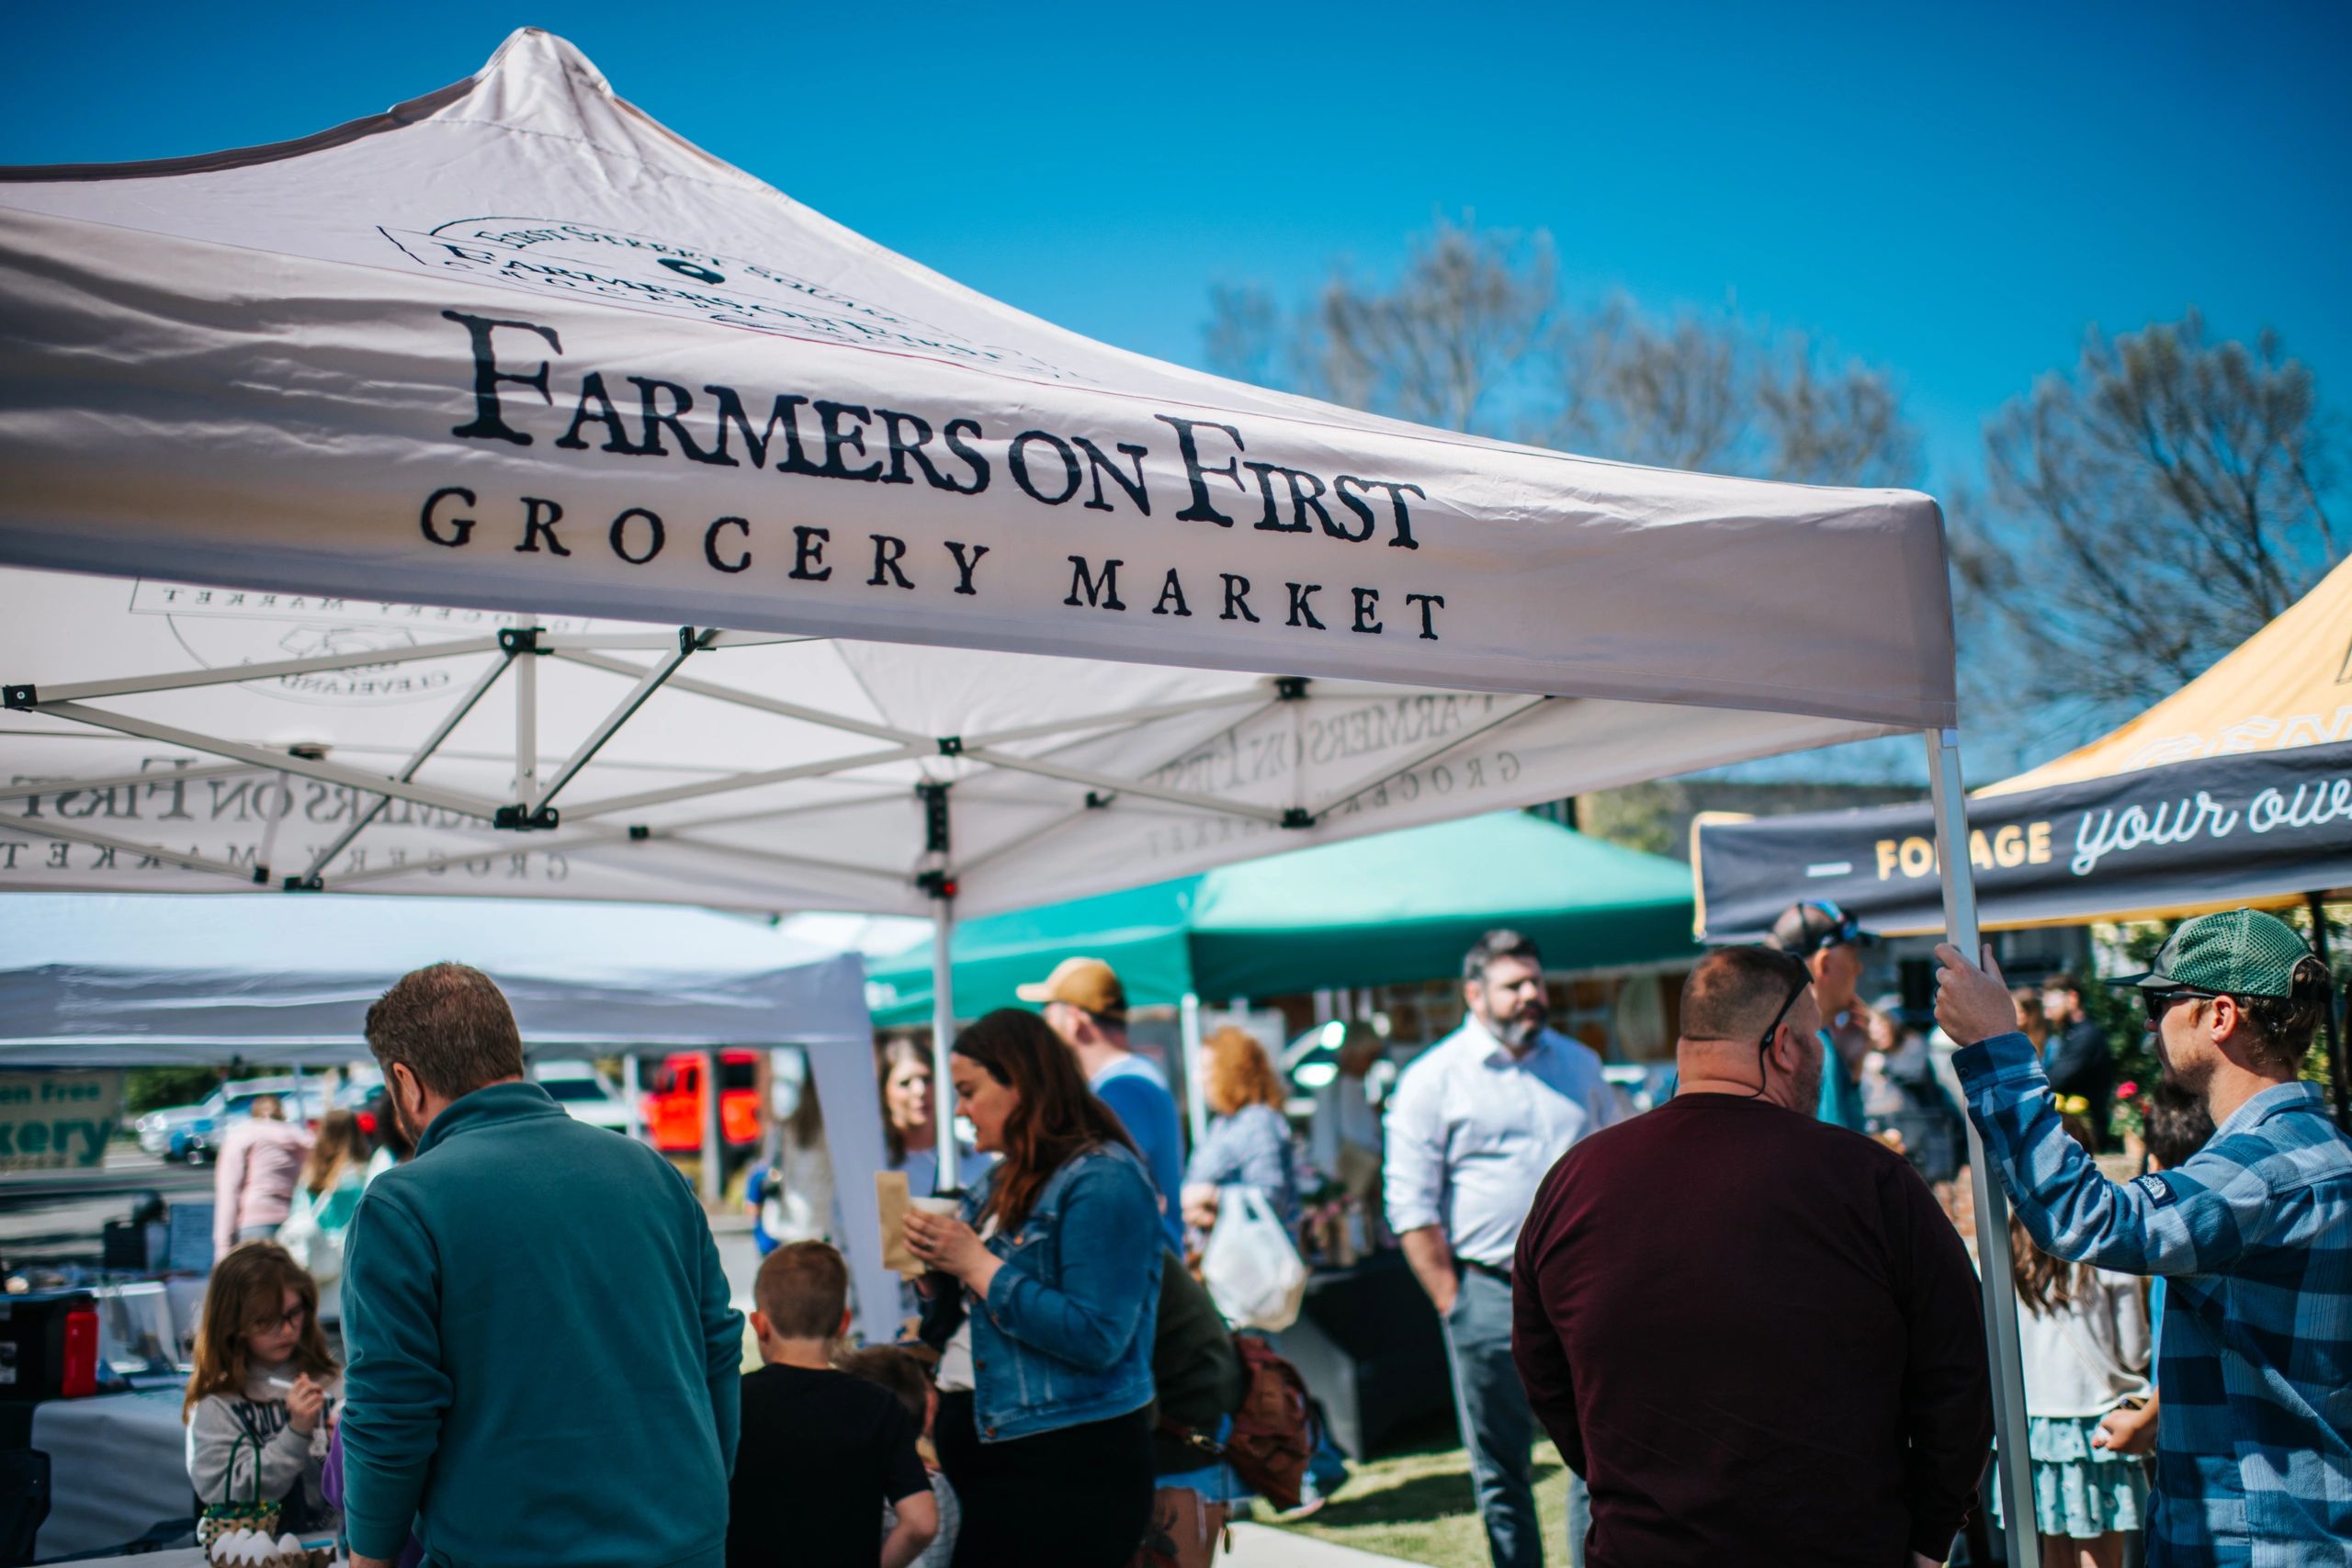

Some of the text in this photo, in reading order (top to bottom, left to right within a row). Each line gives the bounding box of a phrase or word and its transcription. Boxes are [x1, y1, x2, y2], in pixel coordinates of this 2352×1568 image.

[430, 241, 744, 310] FARMERS
[473, 229, 569, 249] FIRST
[440, 310, 1427, 550] FARMERS ON FIRST
[419, 486, 1445, 641] GROCERY MARKET
[1875, 778, 2352, 882] FOAGE your ow
